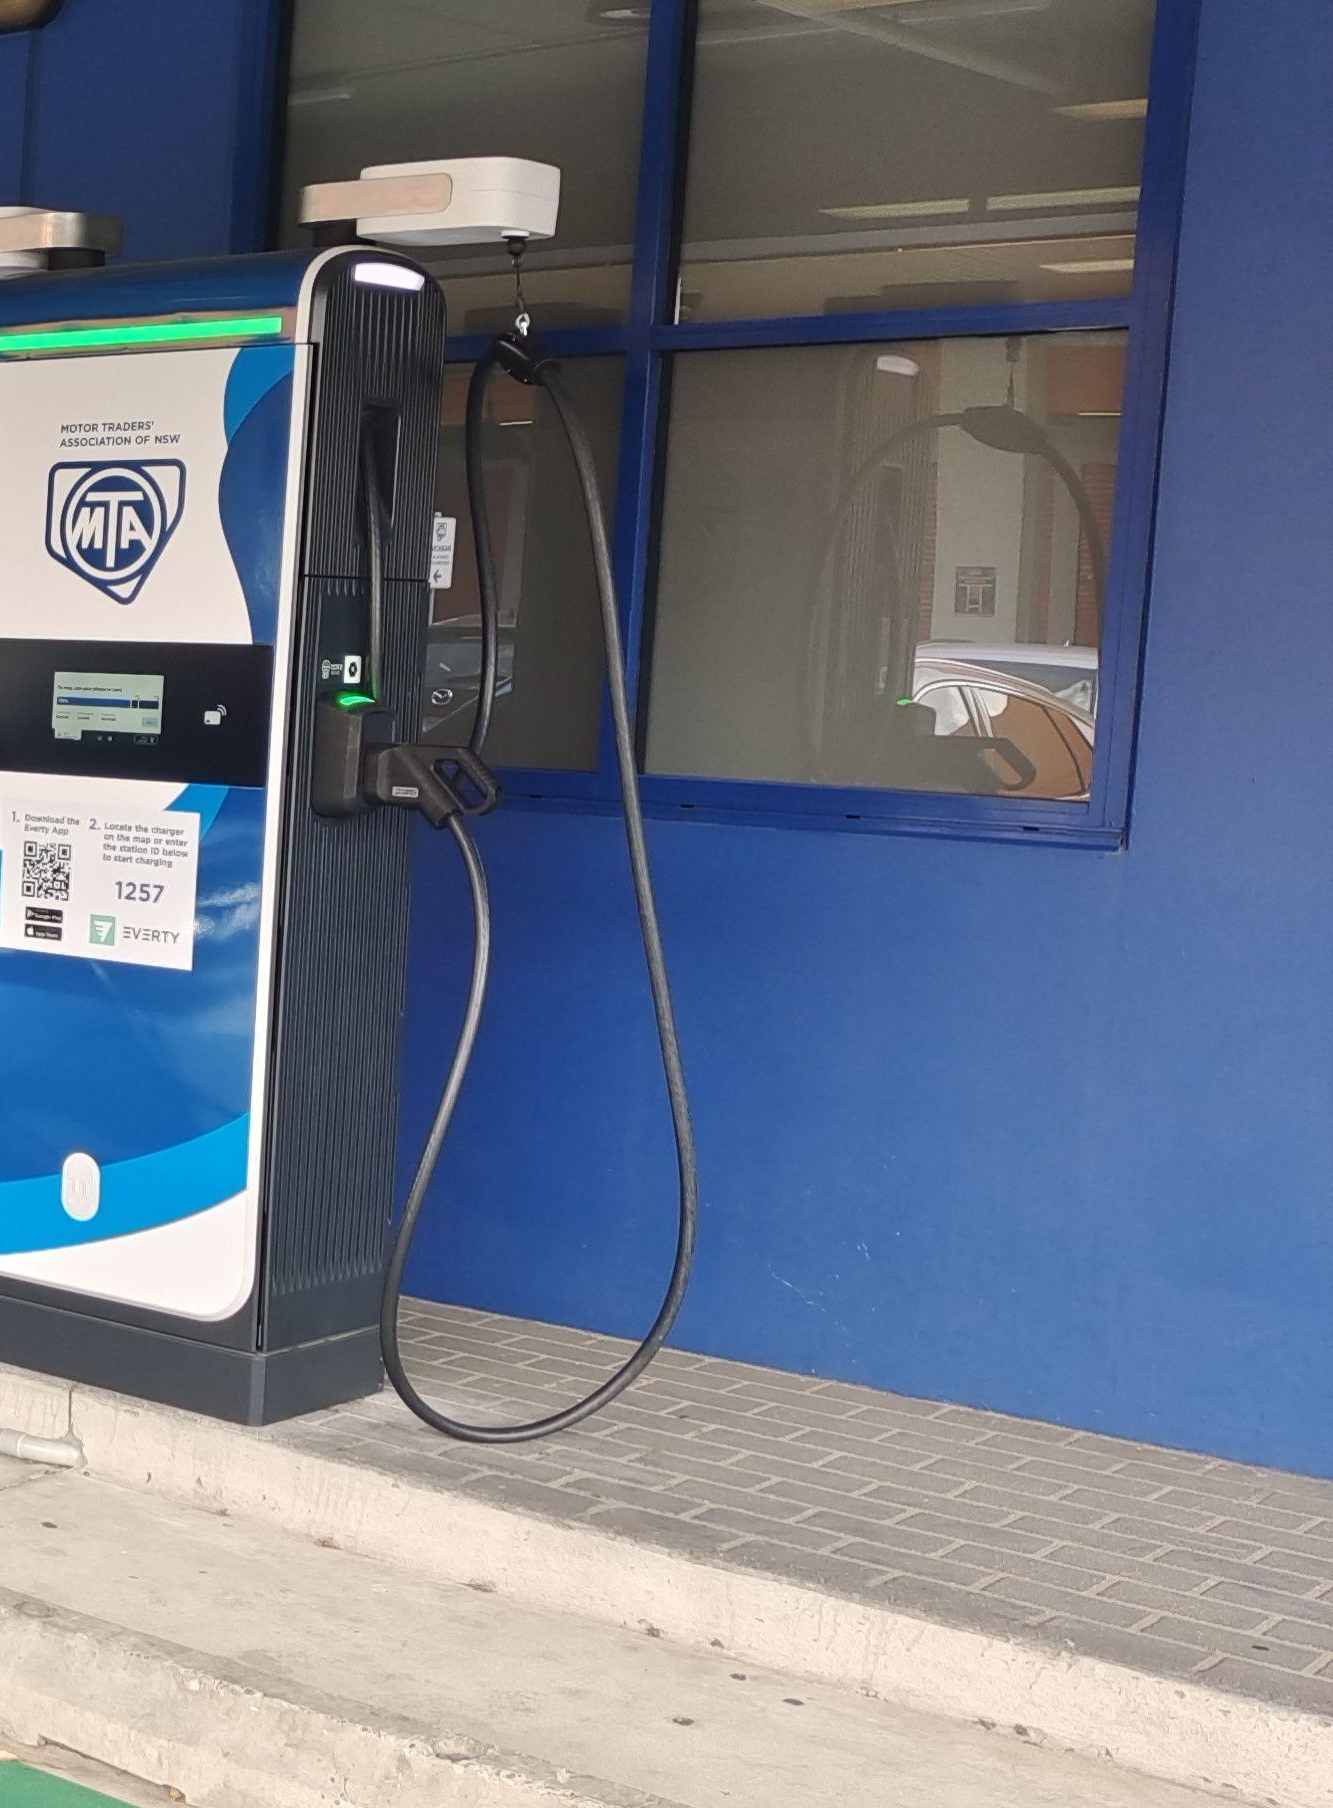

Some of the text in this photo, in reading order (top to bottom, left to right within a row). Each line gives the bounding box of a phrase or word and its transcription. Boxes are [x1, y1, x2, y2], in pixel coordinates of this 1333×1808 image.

[60, 420, 154, 434] MOTOR TRADERS'
[59, 433, 181, 448] ASSOCIATION OF NSW
[72, 490, 151, 568] MTA
[24, 813, 65, 824] Download
[67, 817, 80, 826] the
[24, 824, 69, 836] Everty App
[104, 822, 132, 832] Locate
[134, 824, 149, 833] the
[151, 827, 185, 837] charger
[103, 833, 114, 841] on
[116, 833, 130, 842] the
[132, 835, 151, 845] map
[165, 839, 188, 847] enter
[103, 842, 189, 858] the station ID below
[102, 853, 173, 869] to start charging
[115, 881, 165, 904] 1257
[122, 925, 180, 945] EVERTY
